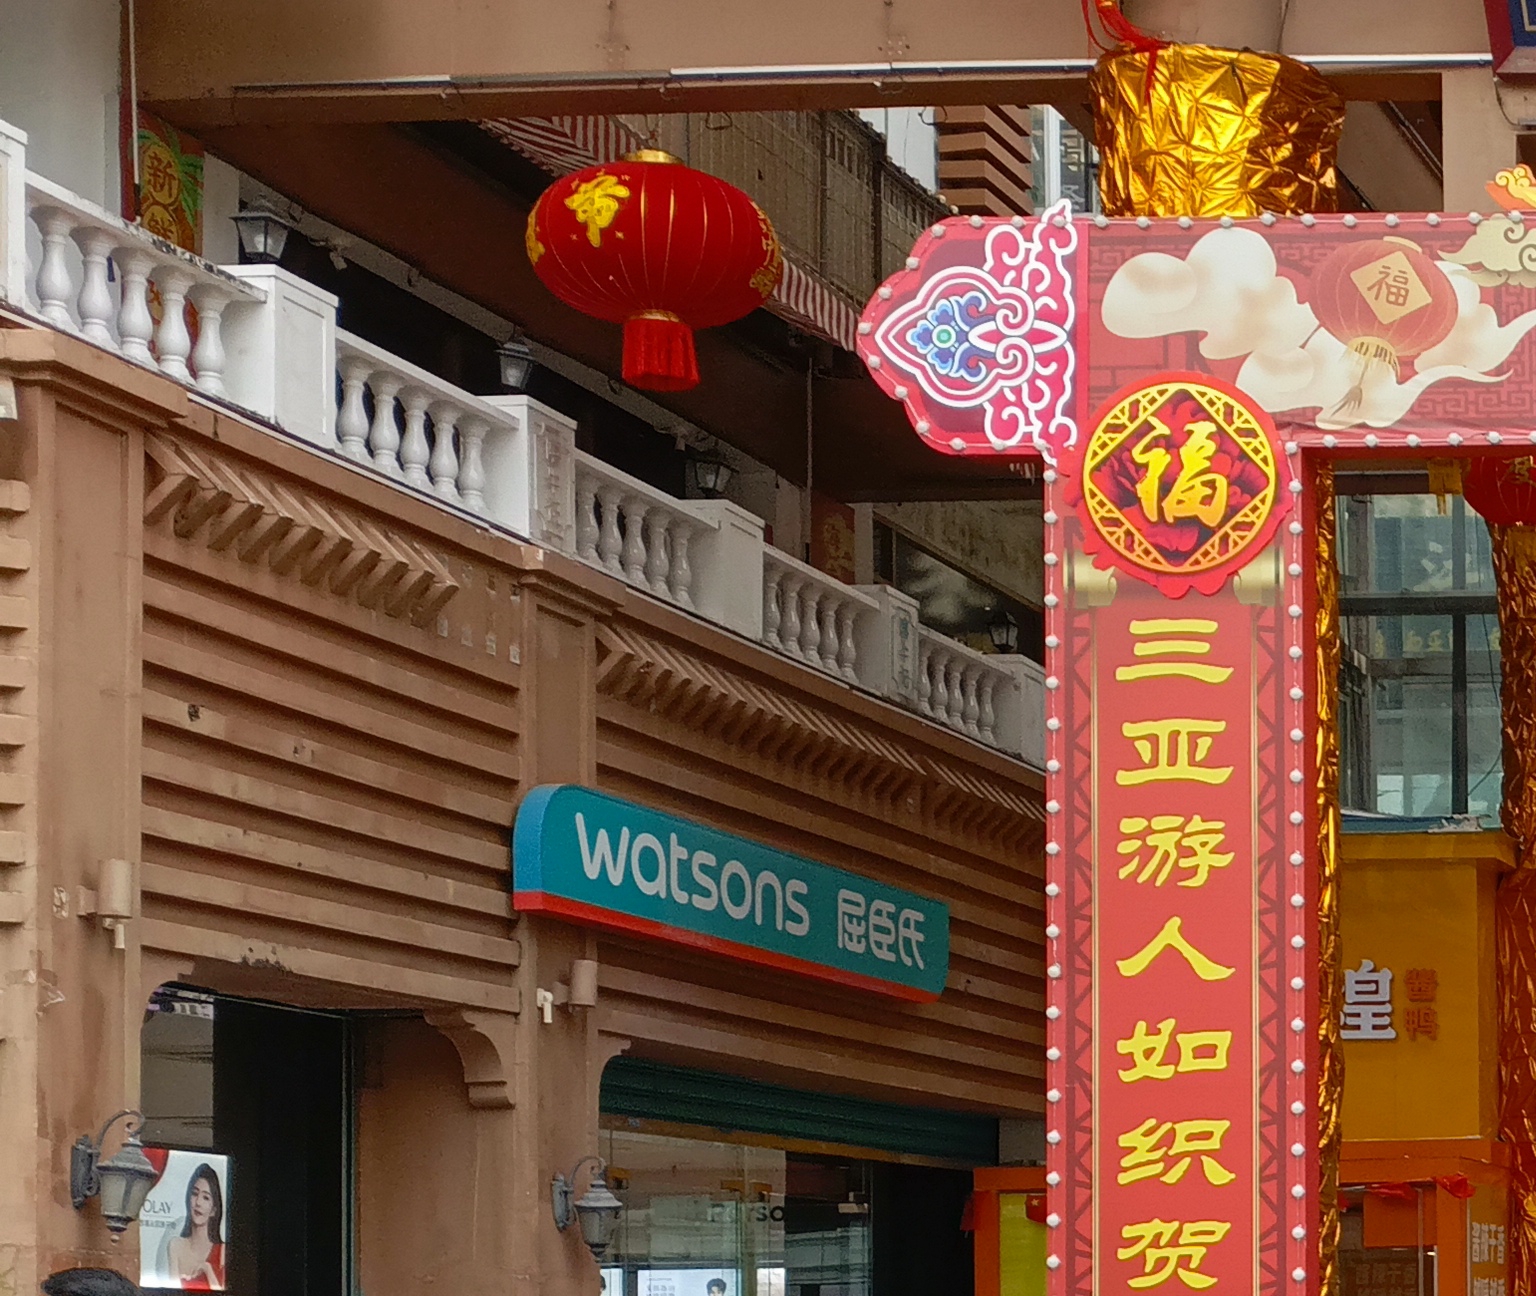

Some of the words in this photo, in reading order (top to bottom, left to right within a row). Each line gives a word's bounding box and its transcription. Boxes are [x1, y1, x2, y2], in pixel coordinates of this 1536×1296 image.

[1366, 265, 1411, 308] 福
[1134, 415, 1232, 529] 福
[836, 887, 926, 971] 屈臣氏
[143, 1198, 173, 1215] OLAY
